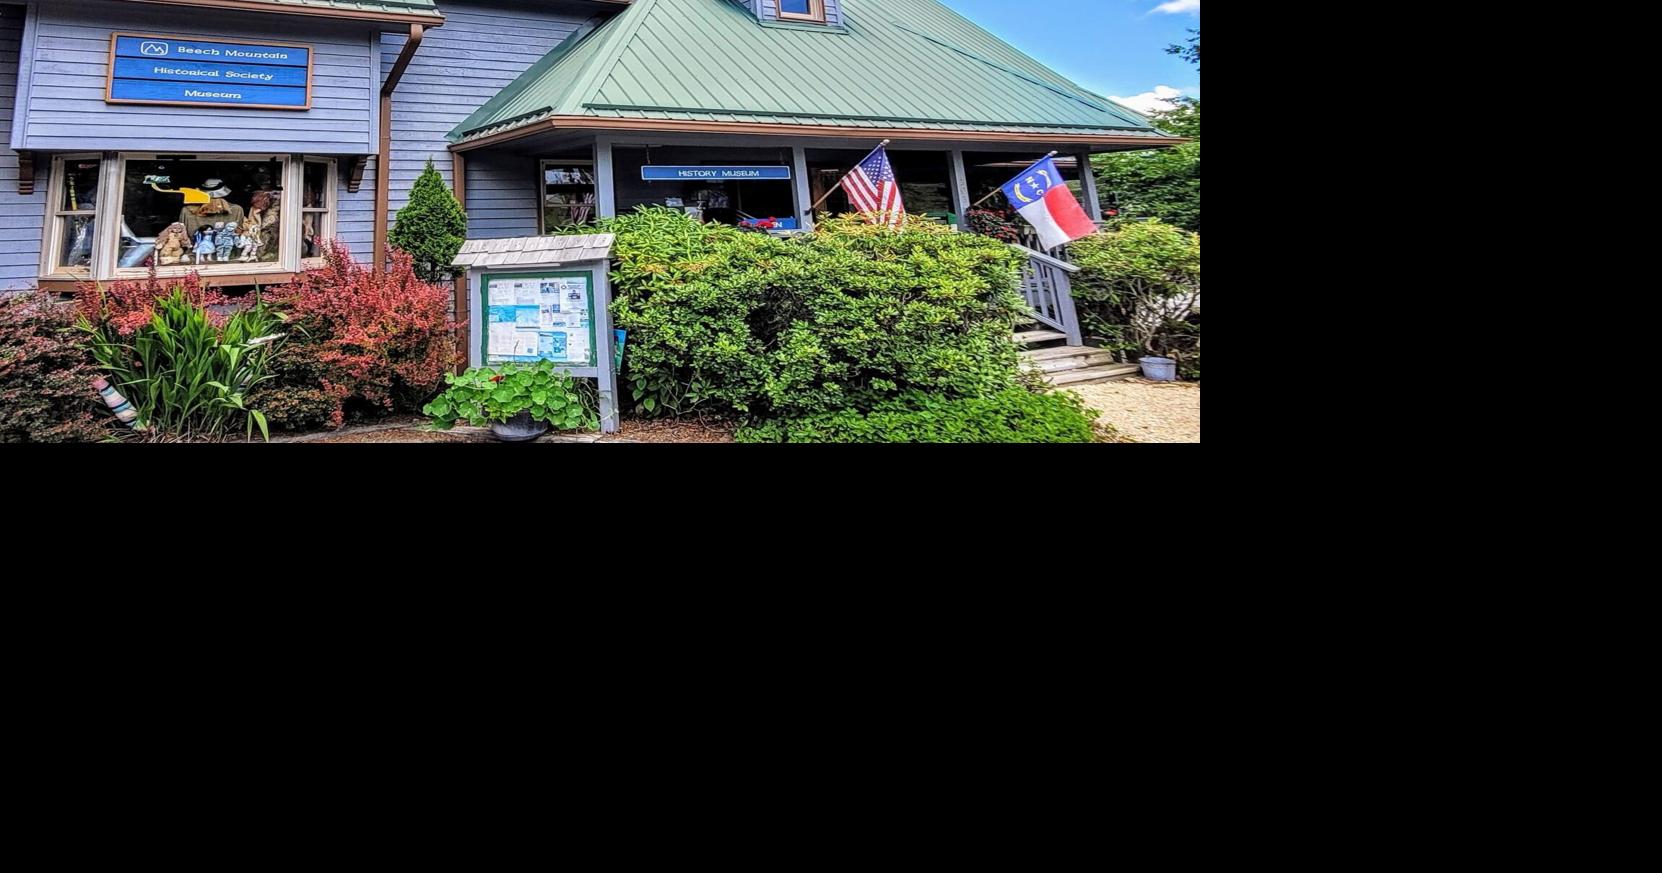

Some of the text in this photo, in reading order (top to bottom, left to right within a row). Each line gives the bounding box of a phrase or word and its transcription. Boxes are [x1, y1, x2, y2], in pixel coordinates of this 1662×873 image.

[177, 46, 288, 60] Beech Mountain
[154, 66, 274, 81] Historical Society
[184, 89, 242, 99] Museum
[1025, 176, 1034, 184] N
